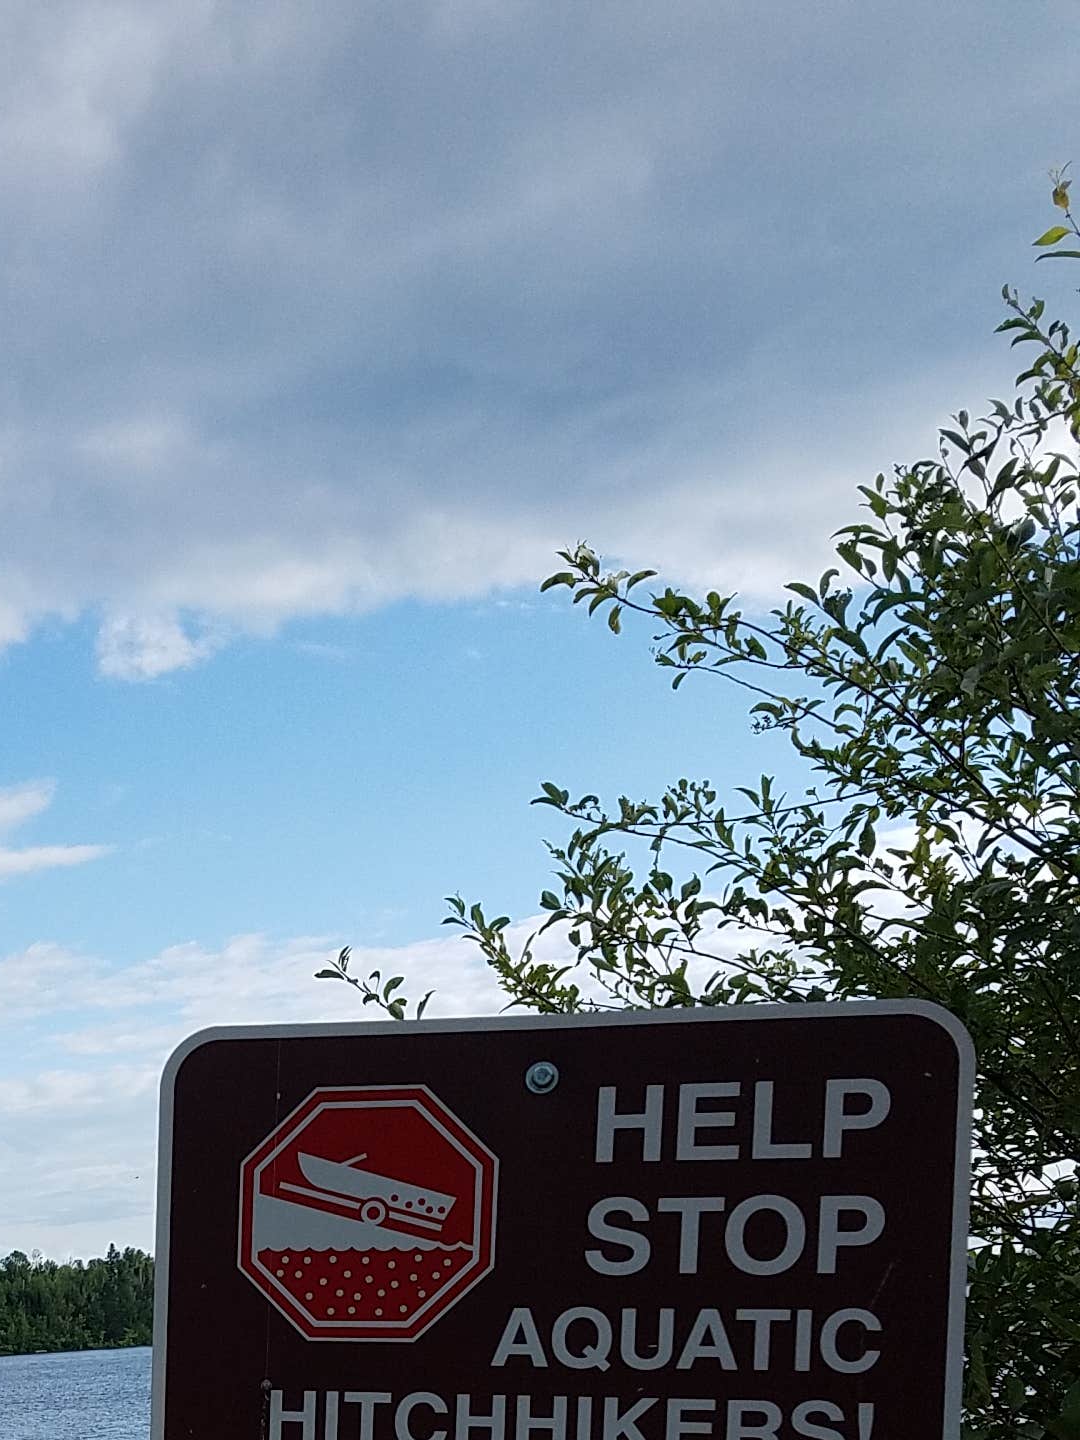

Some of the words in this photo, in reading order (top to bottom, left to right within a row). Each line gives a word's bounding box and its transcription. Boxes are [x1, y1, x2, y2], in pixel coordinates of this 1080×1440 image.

[597, 1079, 890, 1161] HELP
[586, 1195, 884, 1275] STOP
[492, 1307, 880, 1372] AQUATIC
